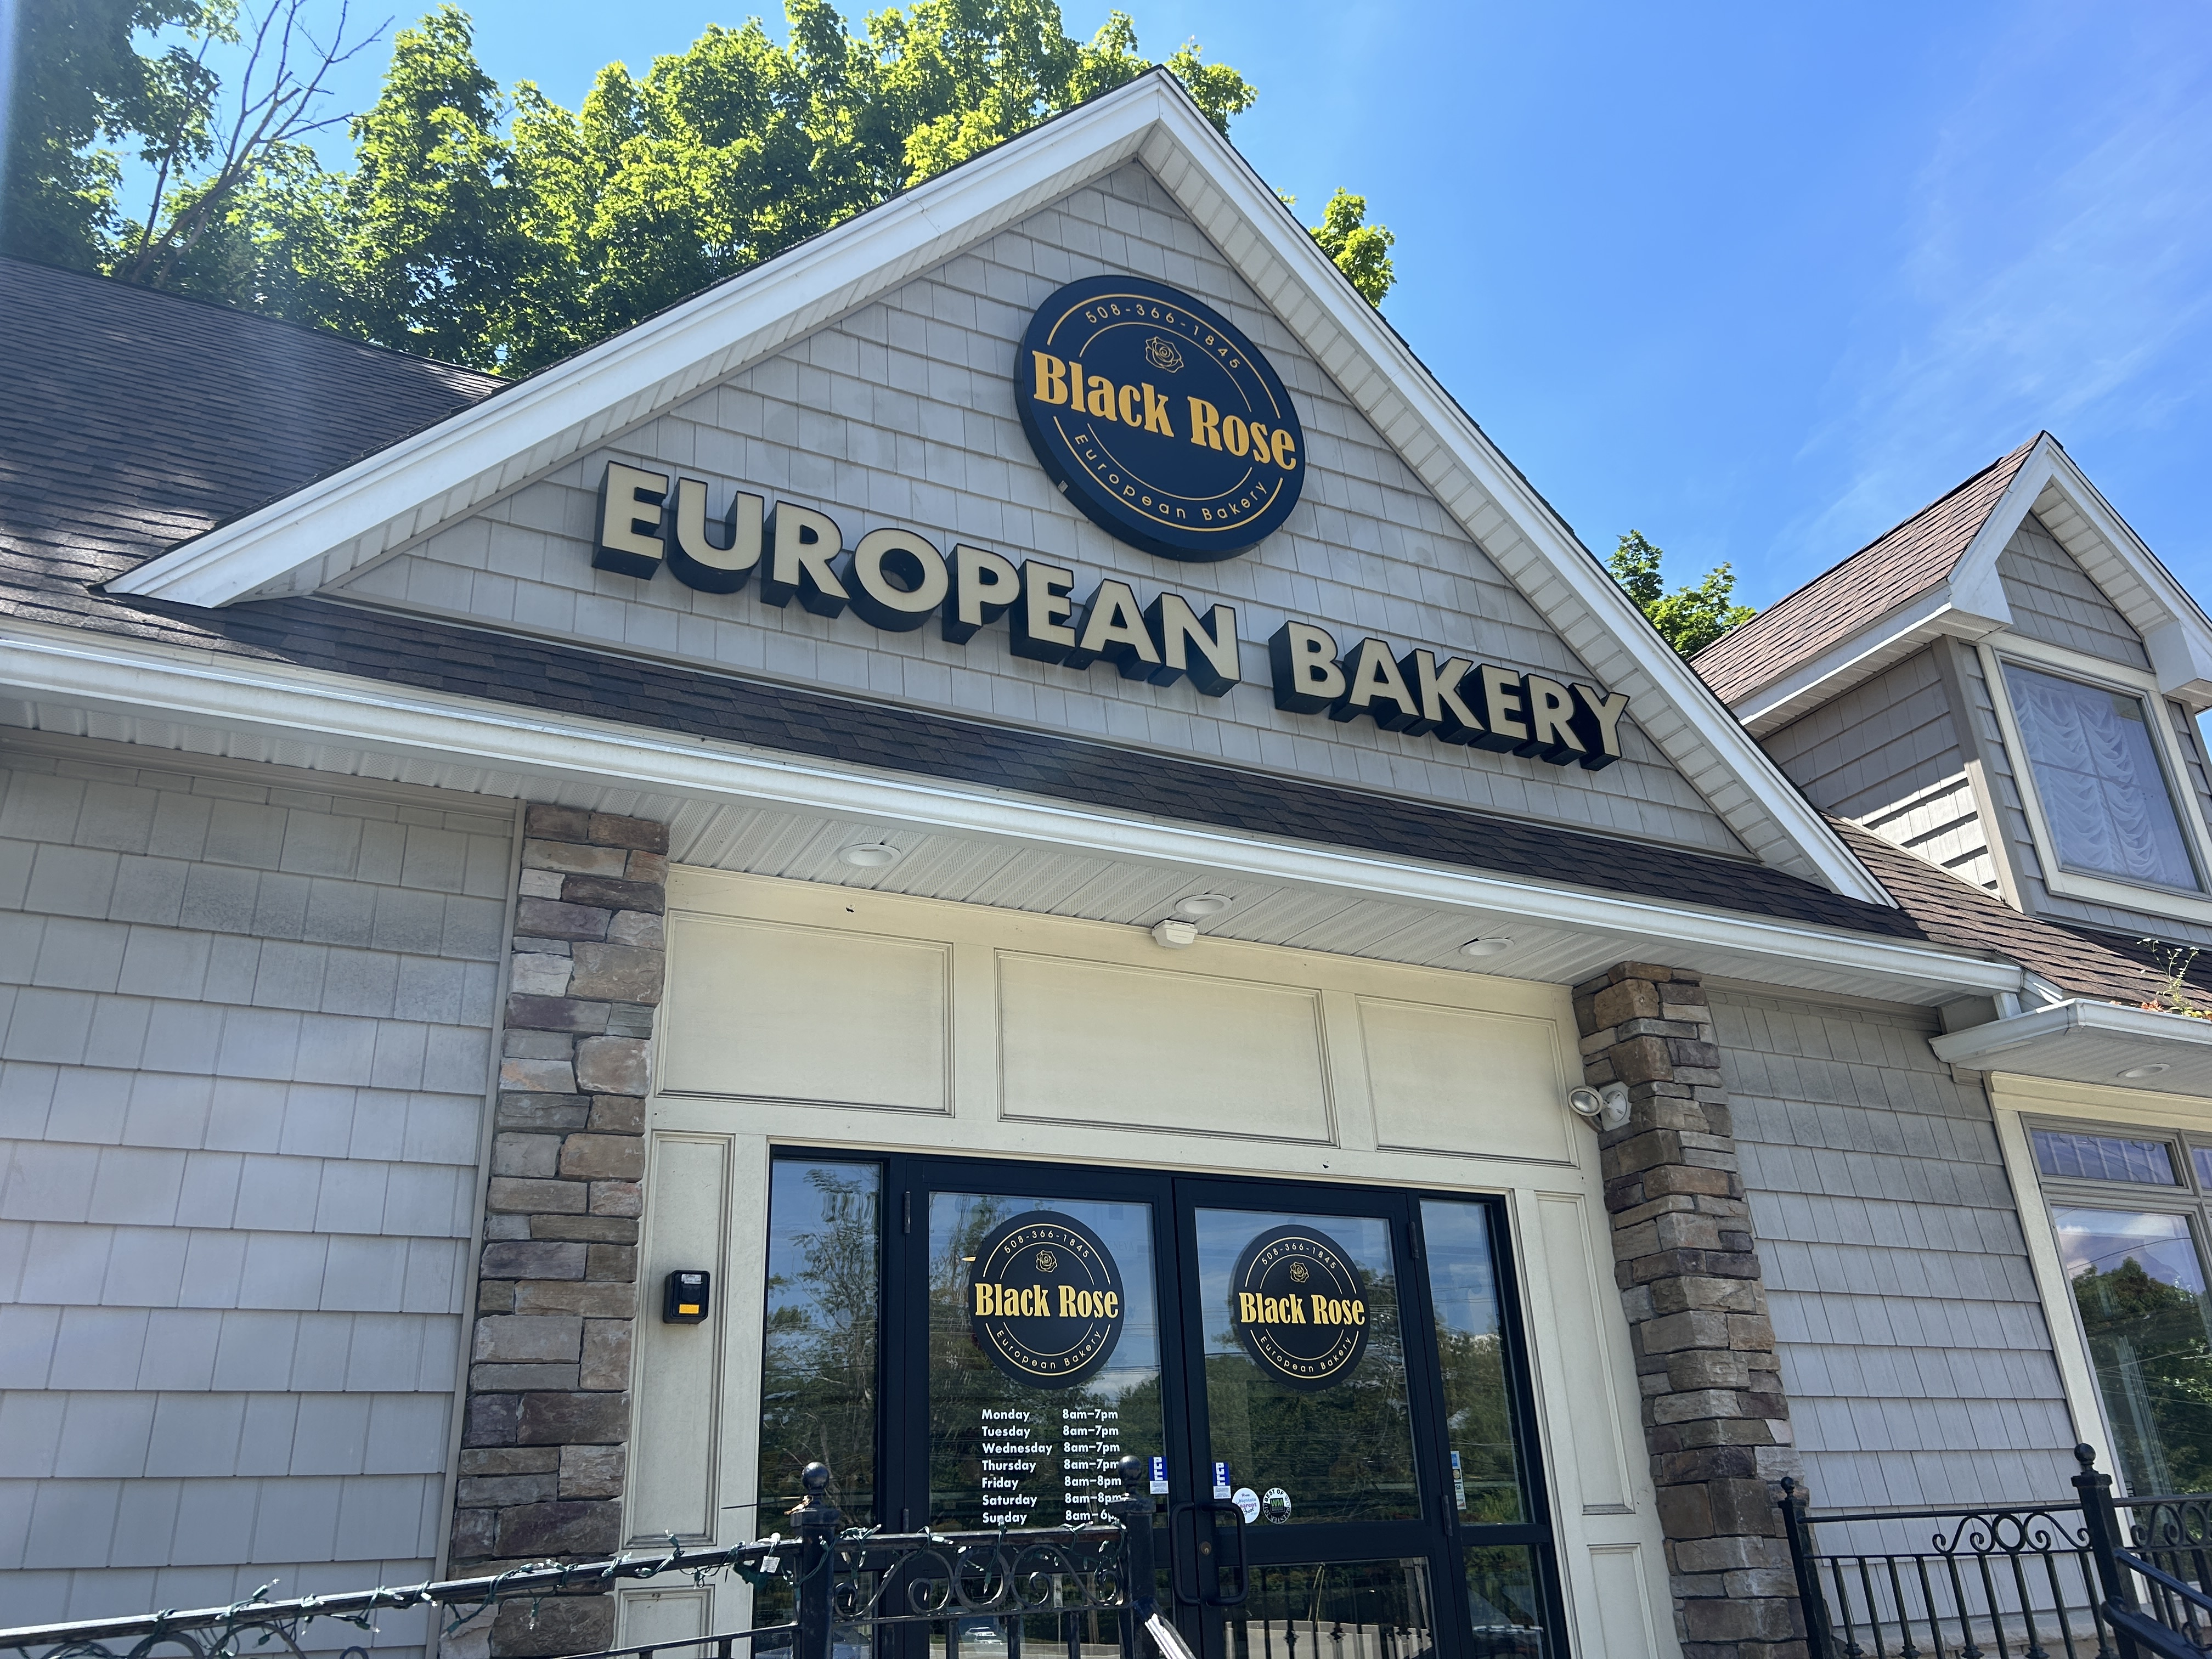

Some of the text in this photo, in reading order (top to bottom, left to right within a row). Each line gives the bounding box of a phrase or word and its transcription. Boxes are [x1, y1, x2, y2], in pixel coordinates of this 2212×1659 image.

[1085, 304, 1240, 369] 508-366-1845
[1032, 351, 1297, 471] Black Rose
[1075, 434, 1268, 521] European Bakery
[594, 461, 1629, 766] EUROPEAN BAKERY
[1004, 1230, 1090, 1258] 508-366-1845
[1262, 1243, 1336, 1269] 508-366-1845
[975, 1283, 1119, 1319] Black Rose
[1239, 1292, 1365, 1325] Black Rose
[996, 1330, 1102, 1370] European Bakery
[1261, 1336, 1352, 1373] European Bakery
[981, 1408, 1030, 1422] Monday
[982, 1425, 1031, 1438] Tuesday
[982, 1442, 1053, 1455] Wednesday
[982, 1459, 1036, 1473] Thursday
[1153, 1457, 1164, 1481] PULL
[1216, 1462, 1226, 1486] PULL
[982, 1477, 1019, 1490] Friday
[1264, 1488, 1275, 1502] BEST
[982, 1494, 1037, 1508] Saturday
[1271, 1499, 1283, 1507] WM
[983, 1511, 1027, 1525] Sunday
